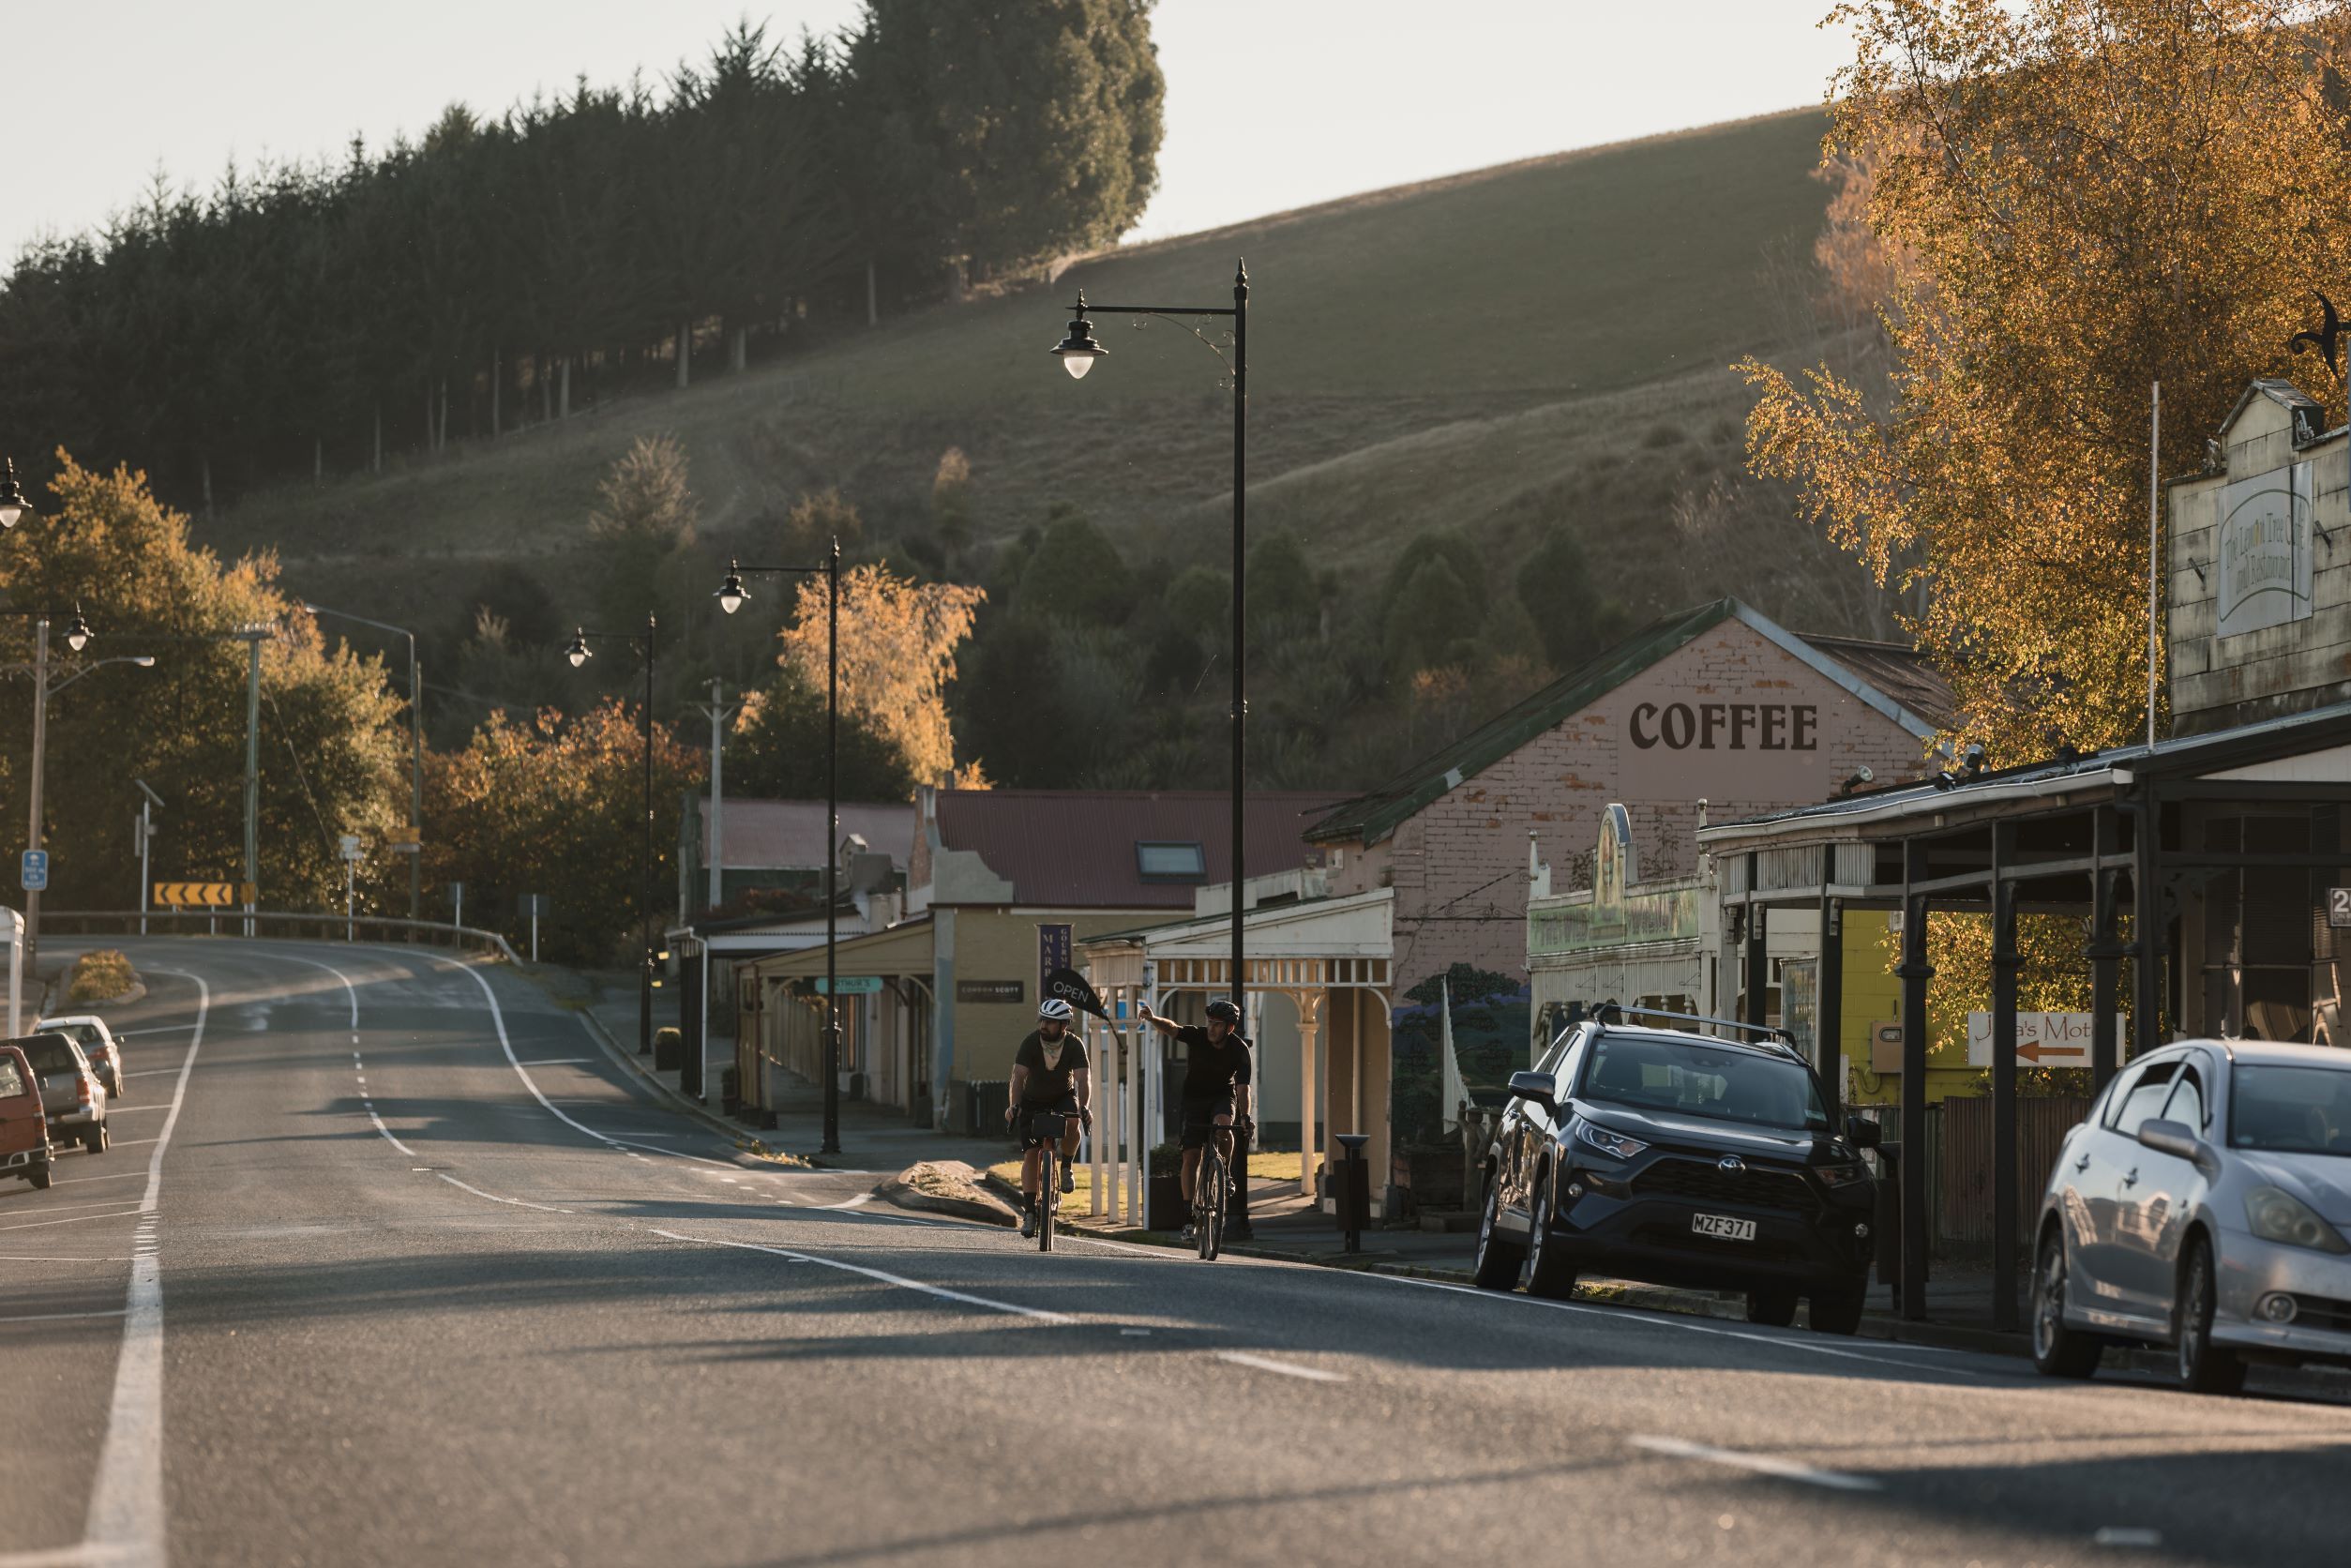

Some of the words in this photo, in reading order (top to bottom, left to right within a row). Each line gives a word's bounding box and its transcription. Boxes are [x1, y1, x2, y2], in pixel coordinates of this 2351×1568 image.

[2267, 513, 2283, 543] Tree
[1629, 702, 1817, 751] COFFEE
[2334, 891, 2351, 912] 2
[1053, 981, 1088, 1003] OPEN
[1694, 1214, 1752, 1238] MZF371
